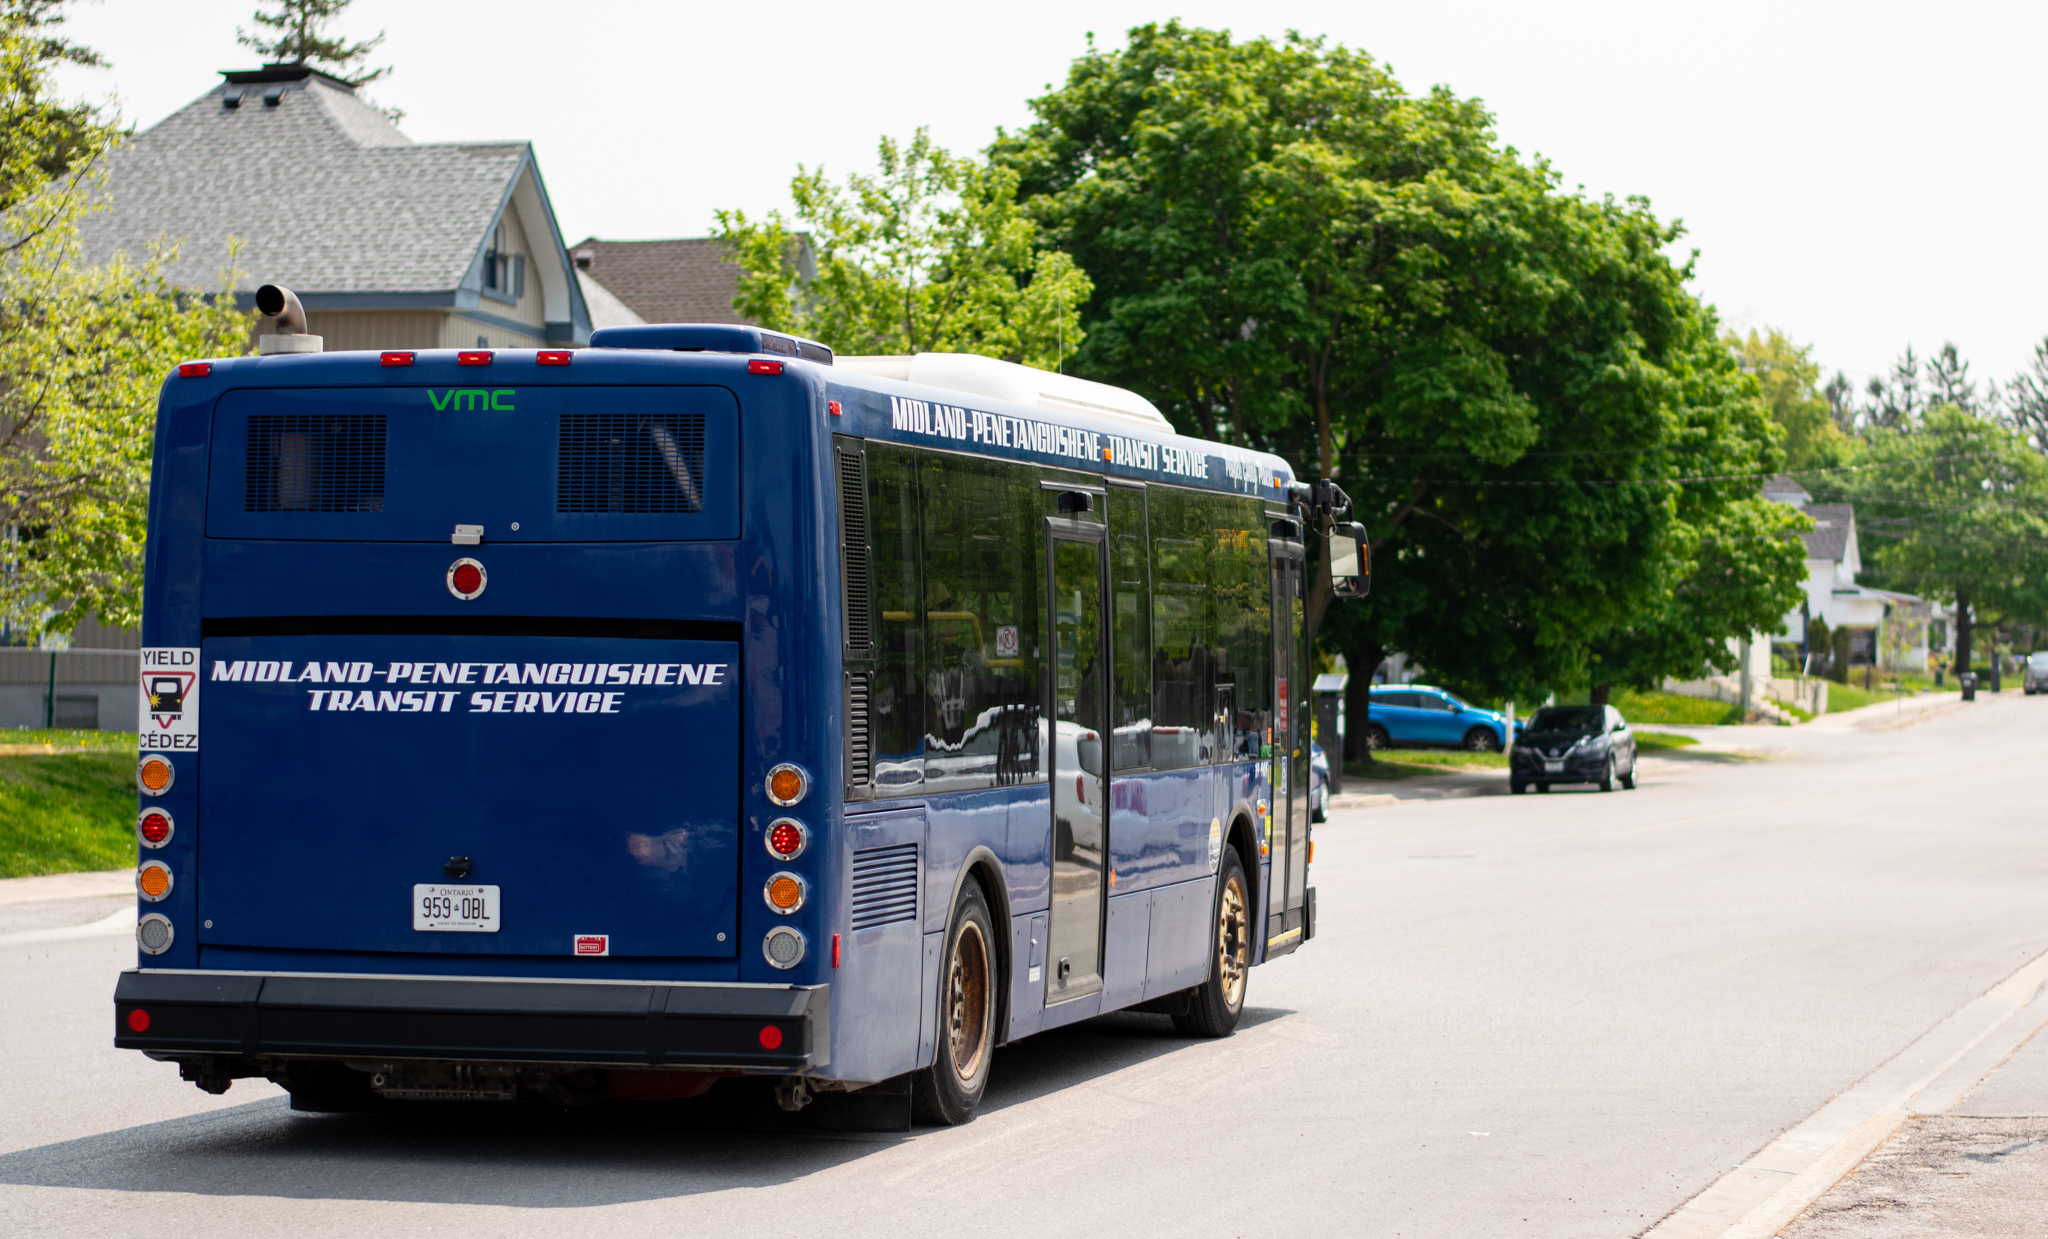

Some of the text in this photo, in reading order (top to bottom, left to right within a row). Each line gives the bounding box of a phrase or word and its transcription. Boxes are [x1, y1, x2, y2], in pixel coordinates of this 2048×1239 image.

[427, 389, 516, 411] VMC
[890, 396, 1209, 479] MIDLAND-PENETANGUISHENE TRANSIT SERVICE
[143, 650, 195, 665] YIELD
[210, 660, 728, 685] MIDLAND-PENETANGUISHENE
[307, 689, 625, 713] TRANSIT SERVICE
[139, 730, 198, 749] CÉDEZ
[422, 896, 451, 919] 959
